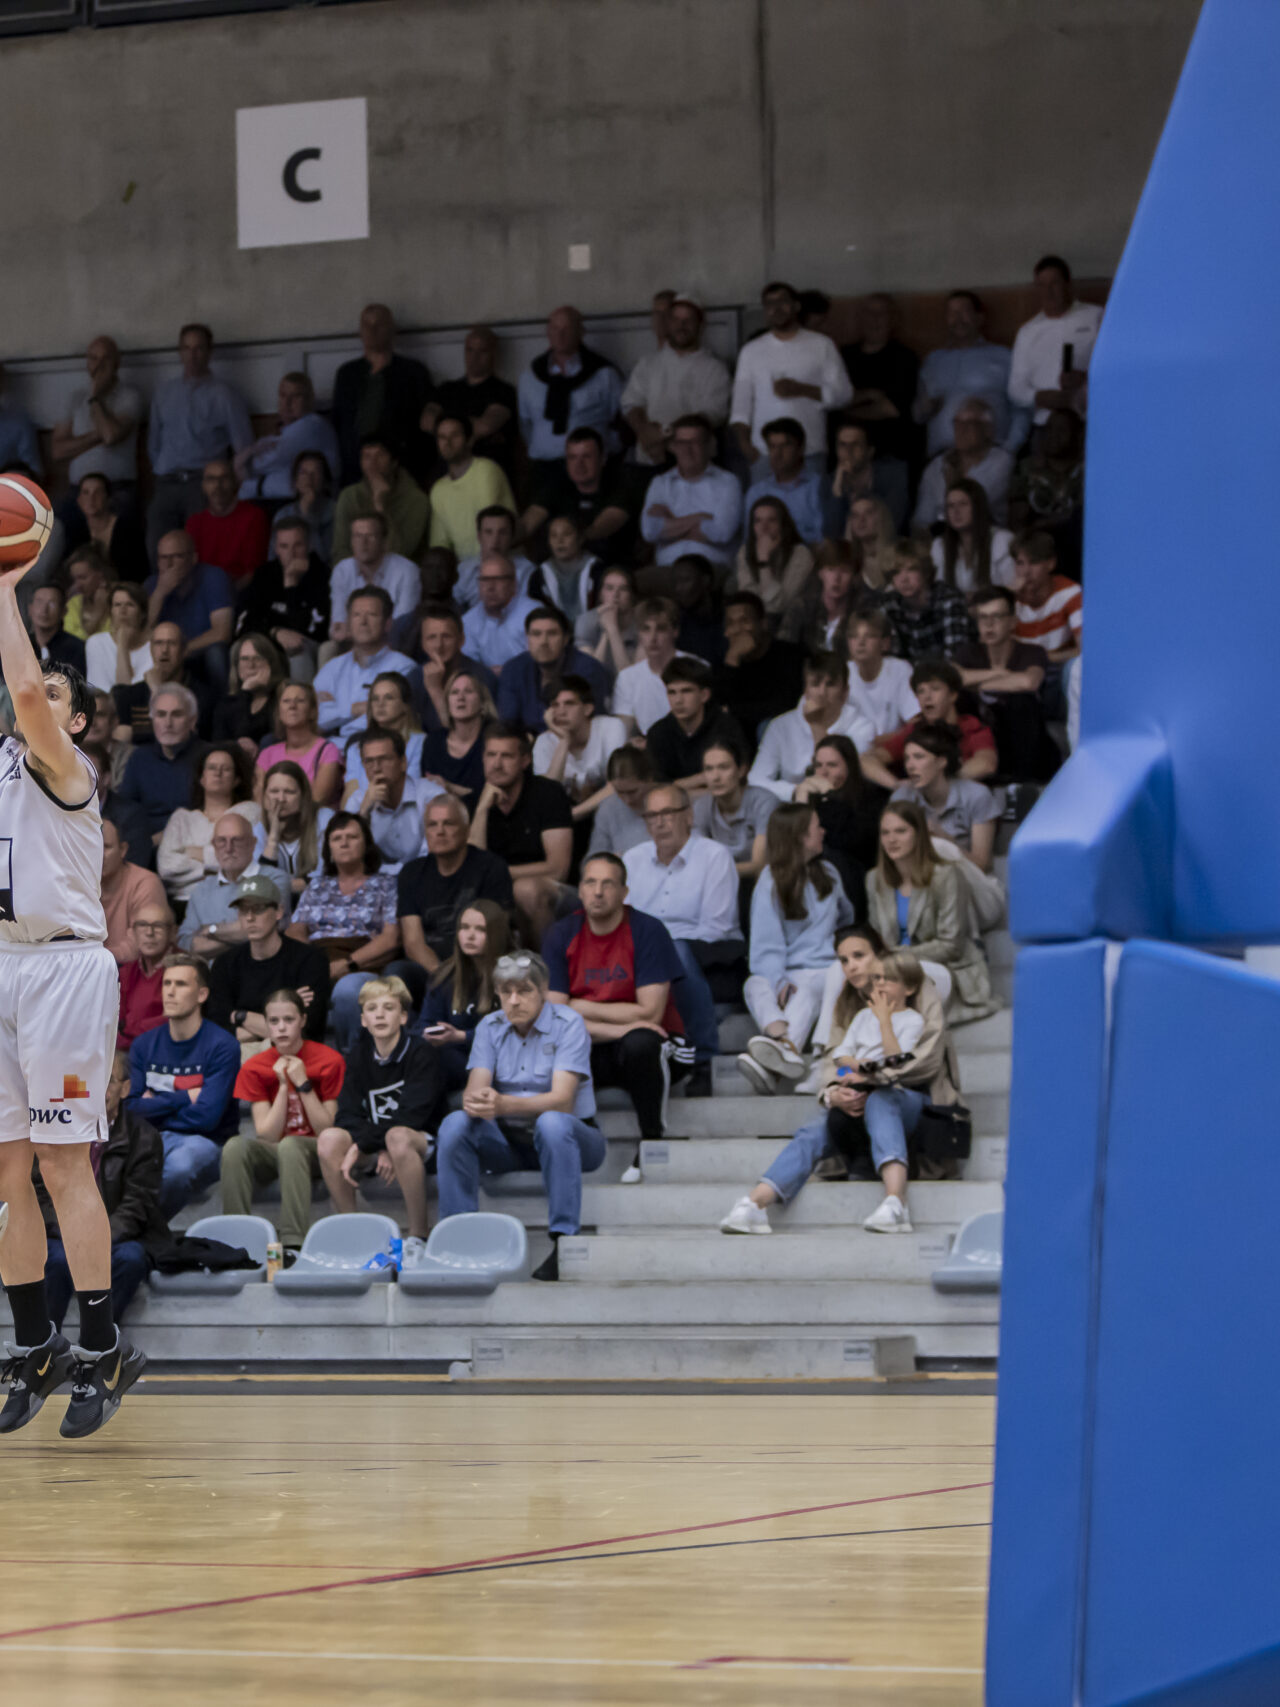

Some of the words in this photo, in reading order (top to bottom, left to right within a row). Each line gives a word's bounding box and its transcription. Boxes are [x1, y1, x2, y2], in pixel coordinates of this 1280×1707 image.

[282, 147, 322, 203] C
[584, 963, 628, 985] FILA
[150, 1063, 202, 1075] TOMMY
[29, 1107, 72, 1127] pwc
